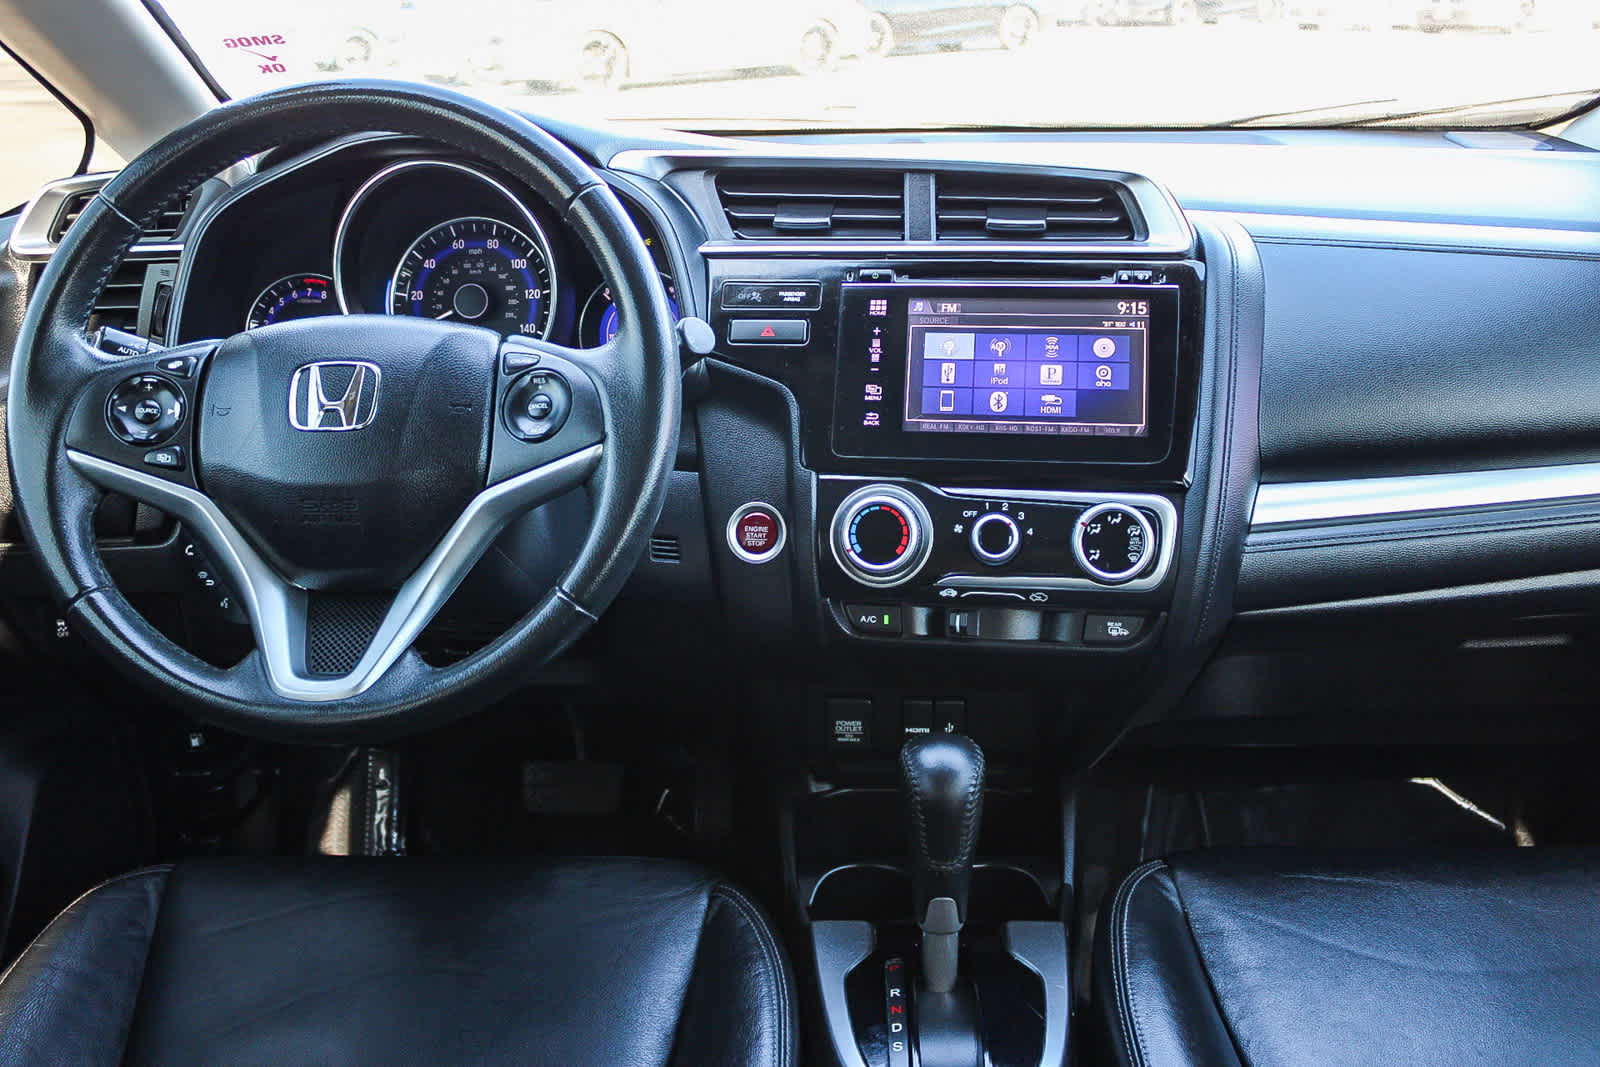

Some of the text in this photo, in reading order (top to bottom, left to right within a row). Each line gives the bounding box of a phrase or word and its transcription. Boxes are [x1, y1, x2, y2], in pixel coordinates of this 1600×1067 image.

[452, 239, 465, 249] 60
[487, 239, 499, 249] 80
[424, 259, 436, 269] 40
[511, 259, 527, 269] 100
[292, 290, 298, 299] 6
[306, 287, 313, 297] 7
[320, 290, 327, 299] 8
[411, 290, 424, 300] 20
[524, 289, 541, 299] 120
[279, 298, 286, 306] 5
[268, 307, 275, 315] 4
[941, 303, 958, 313] FM
[1117, 301, 1147, 315] 9:15
[920, 316, 950, 325] SOURCE
[519, 324, 536, 334] 140
[117, 346, 139, 356] AUTO
[990, 375, 1009, 385] iPod
[1040, 405, 1062, 414] HDMI
[1002, 503, 1009, 511] 2
[1018, 512, 1025, 520] 3
[1026, 528, 1033, 536] 4
[860, 615, 877, 623] A/C
[890, 988, 901, 998] R
[890, 1005, 902, 1015] N
[891, 1022, 902, 1033] D
[892, 1041, 903, 1052] S
